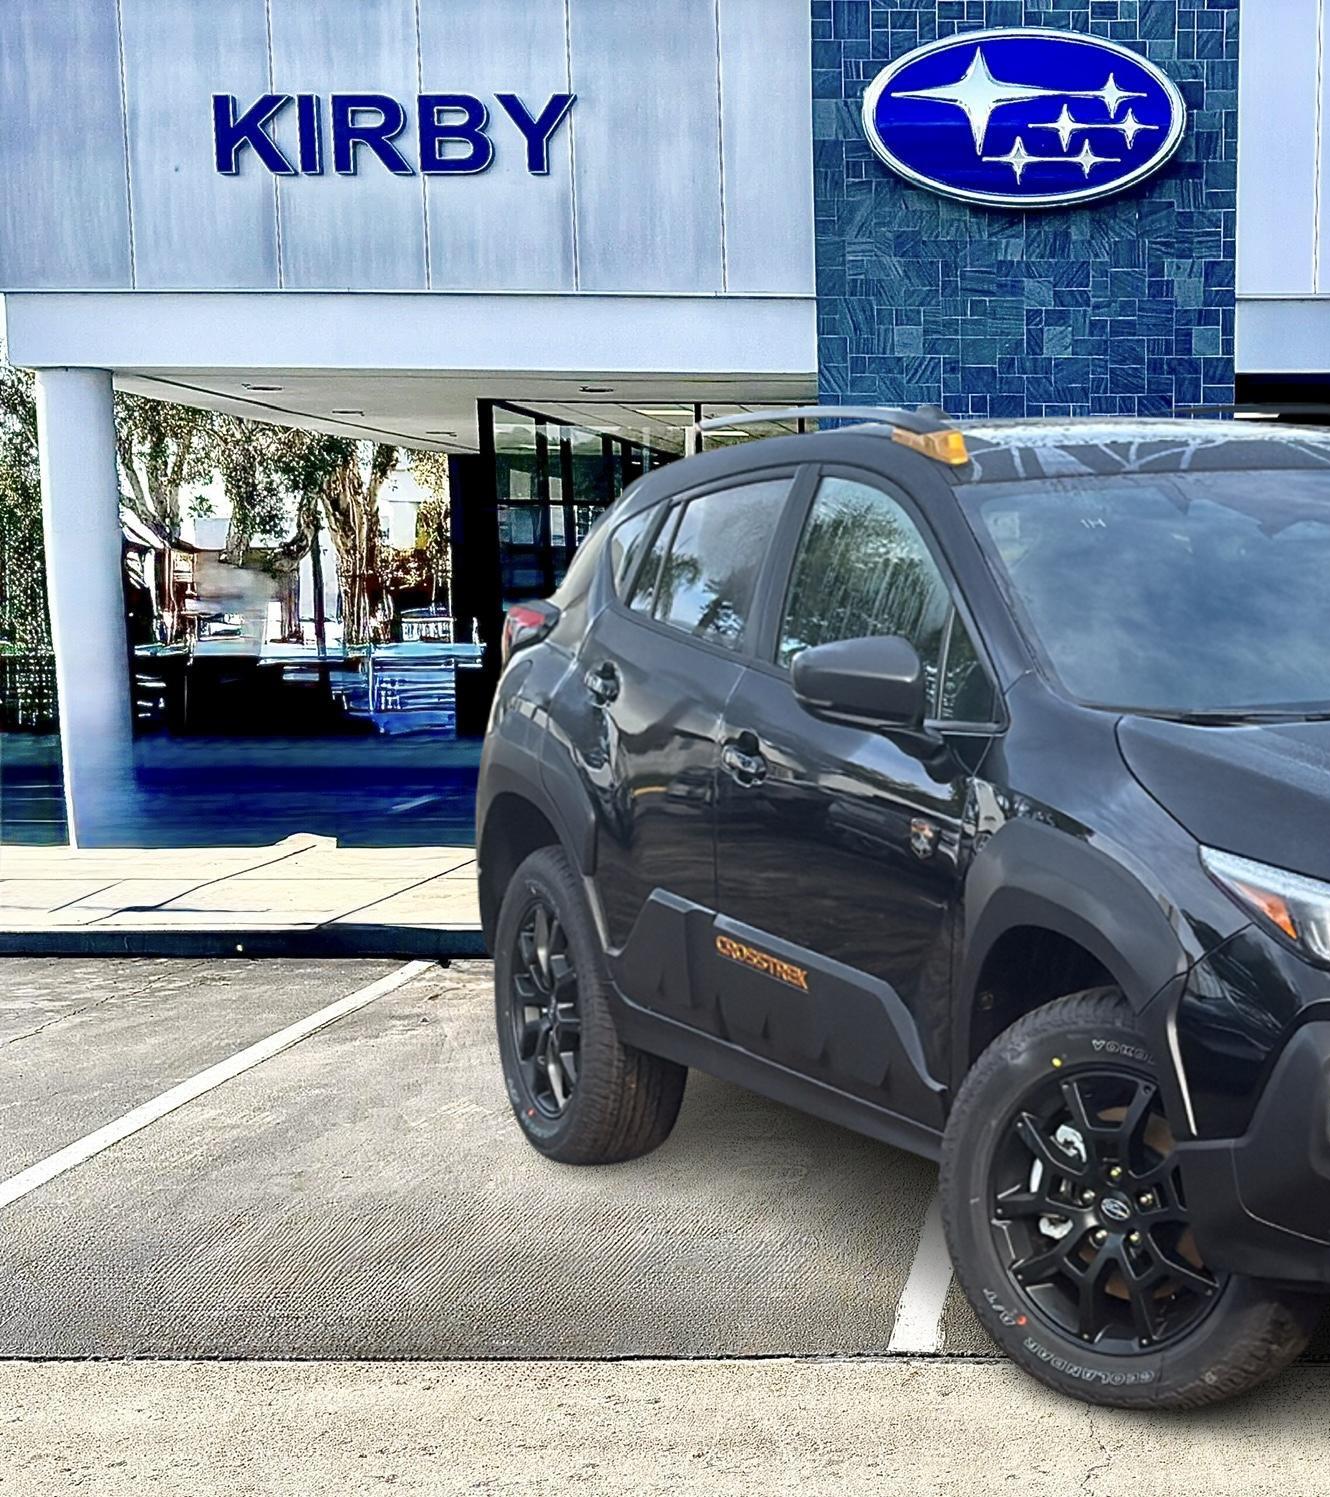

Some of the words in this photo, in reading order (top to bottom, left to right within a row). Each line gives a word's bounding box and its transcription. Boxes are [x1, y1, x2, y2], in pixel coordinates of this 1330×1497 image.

[212, 93, 578, 175] KIRBY
[716, 935, 808, 990] CROSSTREK
[1023, 1336, 1155, 1386] GEOLANDAR
